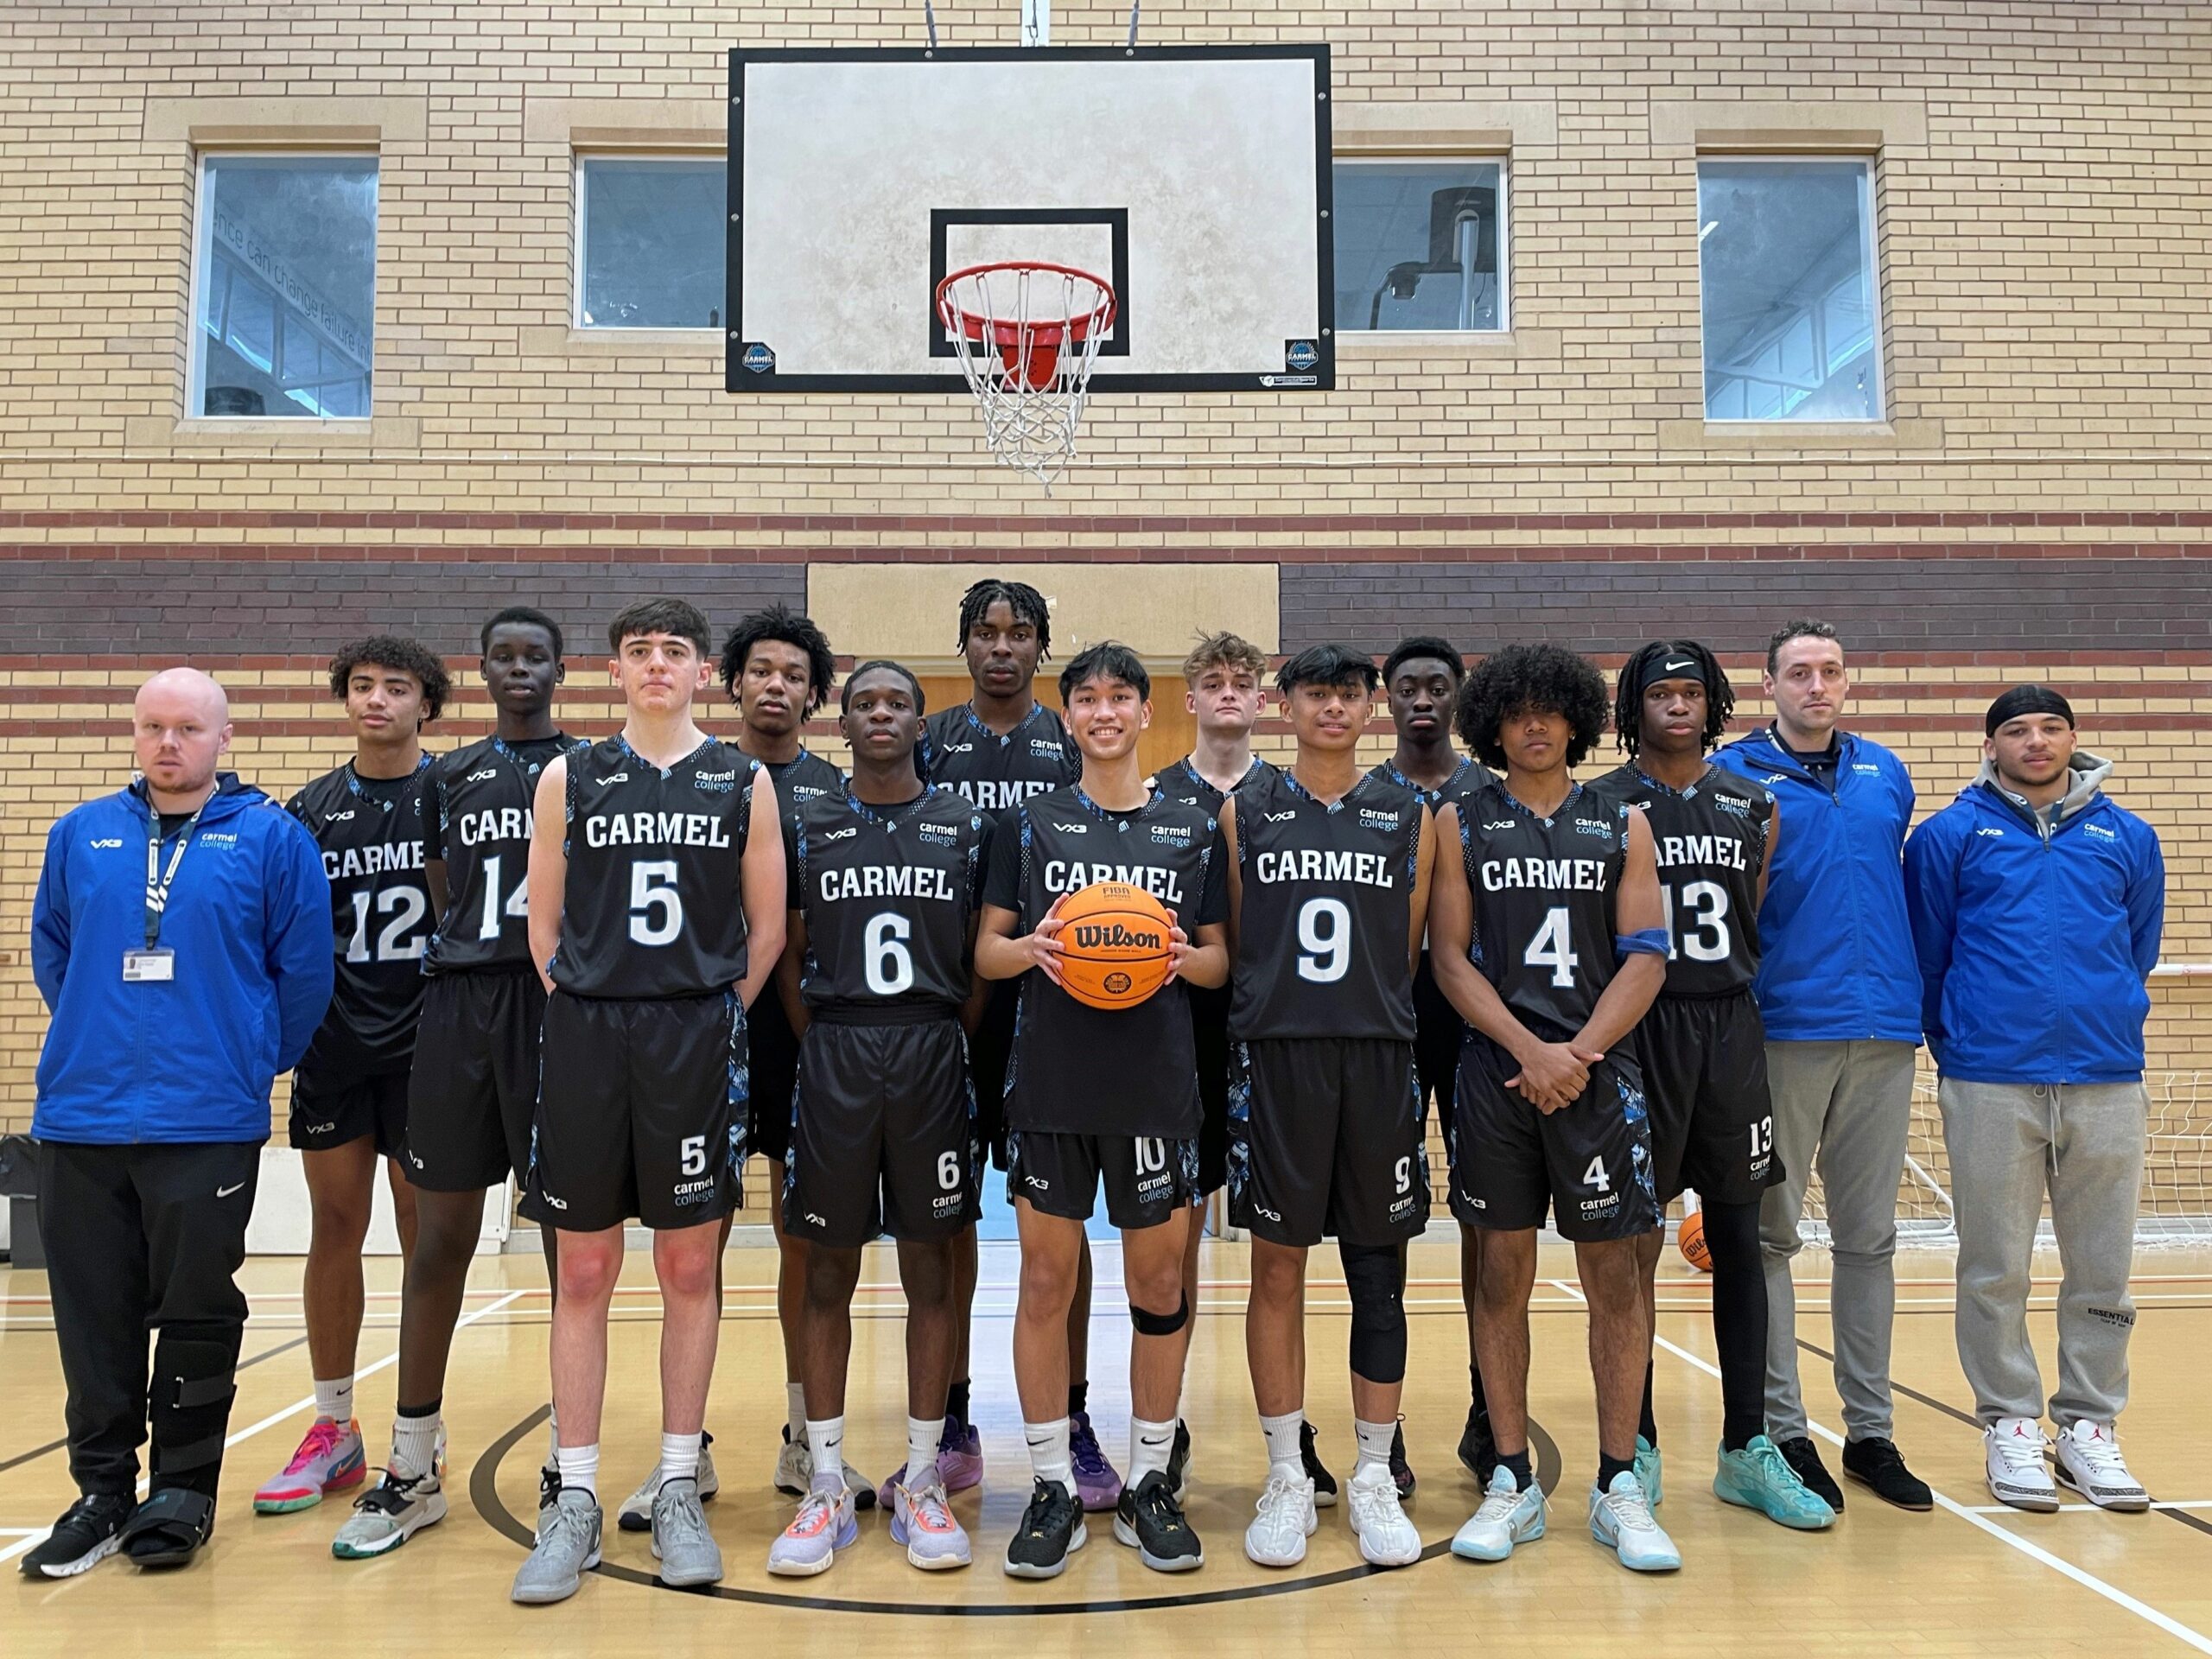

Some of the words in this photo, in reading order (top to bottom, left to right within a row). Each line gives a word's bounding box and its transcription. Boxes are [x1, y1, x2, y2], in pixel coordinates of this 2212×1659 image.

[247, 240, 270, 274] can
[275, 265, 317, 318] change
[321, 303, 355, 352] failure
[467, 769, 496, 782] VX3
[595, 773, 628, 785] VX3
[696, 769, 734, 782] carmel
[694, 780, 734, 792] college
[1715, 793, 1751, 809] carmel
[1715, 803, 1749, 817] college
[325, 810, 355, 821] VX3
[1264, 810, 1295, 822] VX3
[1360, 808, 1398, 821] carmel
[586, 812, 729, 849] CARMEL
[919, 823, 957, 836] carmel
[1052, 823, 1087, 834] VX3
[1151, 824, 1191, 837] carmel
[1359, 818, 1398, 832] college
[1484, 820, 1515, 830] VX3
[1575, 818, 1611, 830] carmel
[1577, 826, 1612, 839] college
[2084, 823, 2114, 837] carmel
[201, 832, 238, 843] carmel
[825, 828, 856, 840] VX3
[919, 833, 957, 847] college
[1151, 835, 1190, 848] college
[1257, 849, 1393, 888] CARMEL
[1482, 857, 1606, 893] CARMEL
[821, 865, 954, 902] CARMEL
[1045, 861, 1183, 904] CARMEL
[629, 861, 683, 946] 5
[346, 885, 427, 963] 12
[1075, 923, 1160, 950] Wilson
[1299, 898, 1351, 982] 9
[864, 912, 914, 995] 6
[1524, 907, 1578, 988] 4
[1750, 1115, 1772, 1157] 13
[681, 1135, 706, 1176] 5
[1135, 1136, 1166, 1175] 10
[938, 1151, 960, 1190] 6
[1395, 1156, 1410, 1194] 9
[1583, 1155, 1610, 1192] 4
[674, 1174, 714, 1195] carmel
[1137, 1171, 1171, 1192] carmel
[675, 1188, 715, 1206] college
[1139, 1184, 1173, 1204] college
[1462, 1190, 1486, 1209] VX3
[1580, 1192, 1619, 1211] carmel
[1254, 1204, 1281, 1222] VX3
[1582, 1205, 1620, 1221] college
